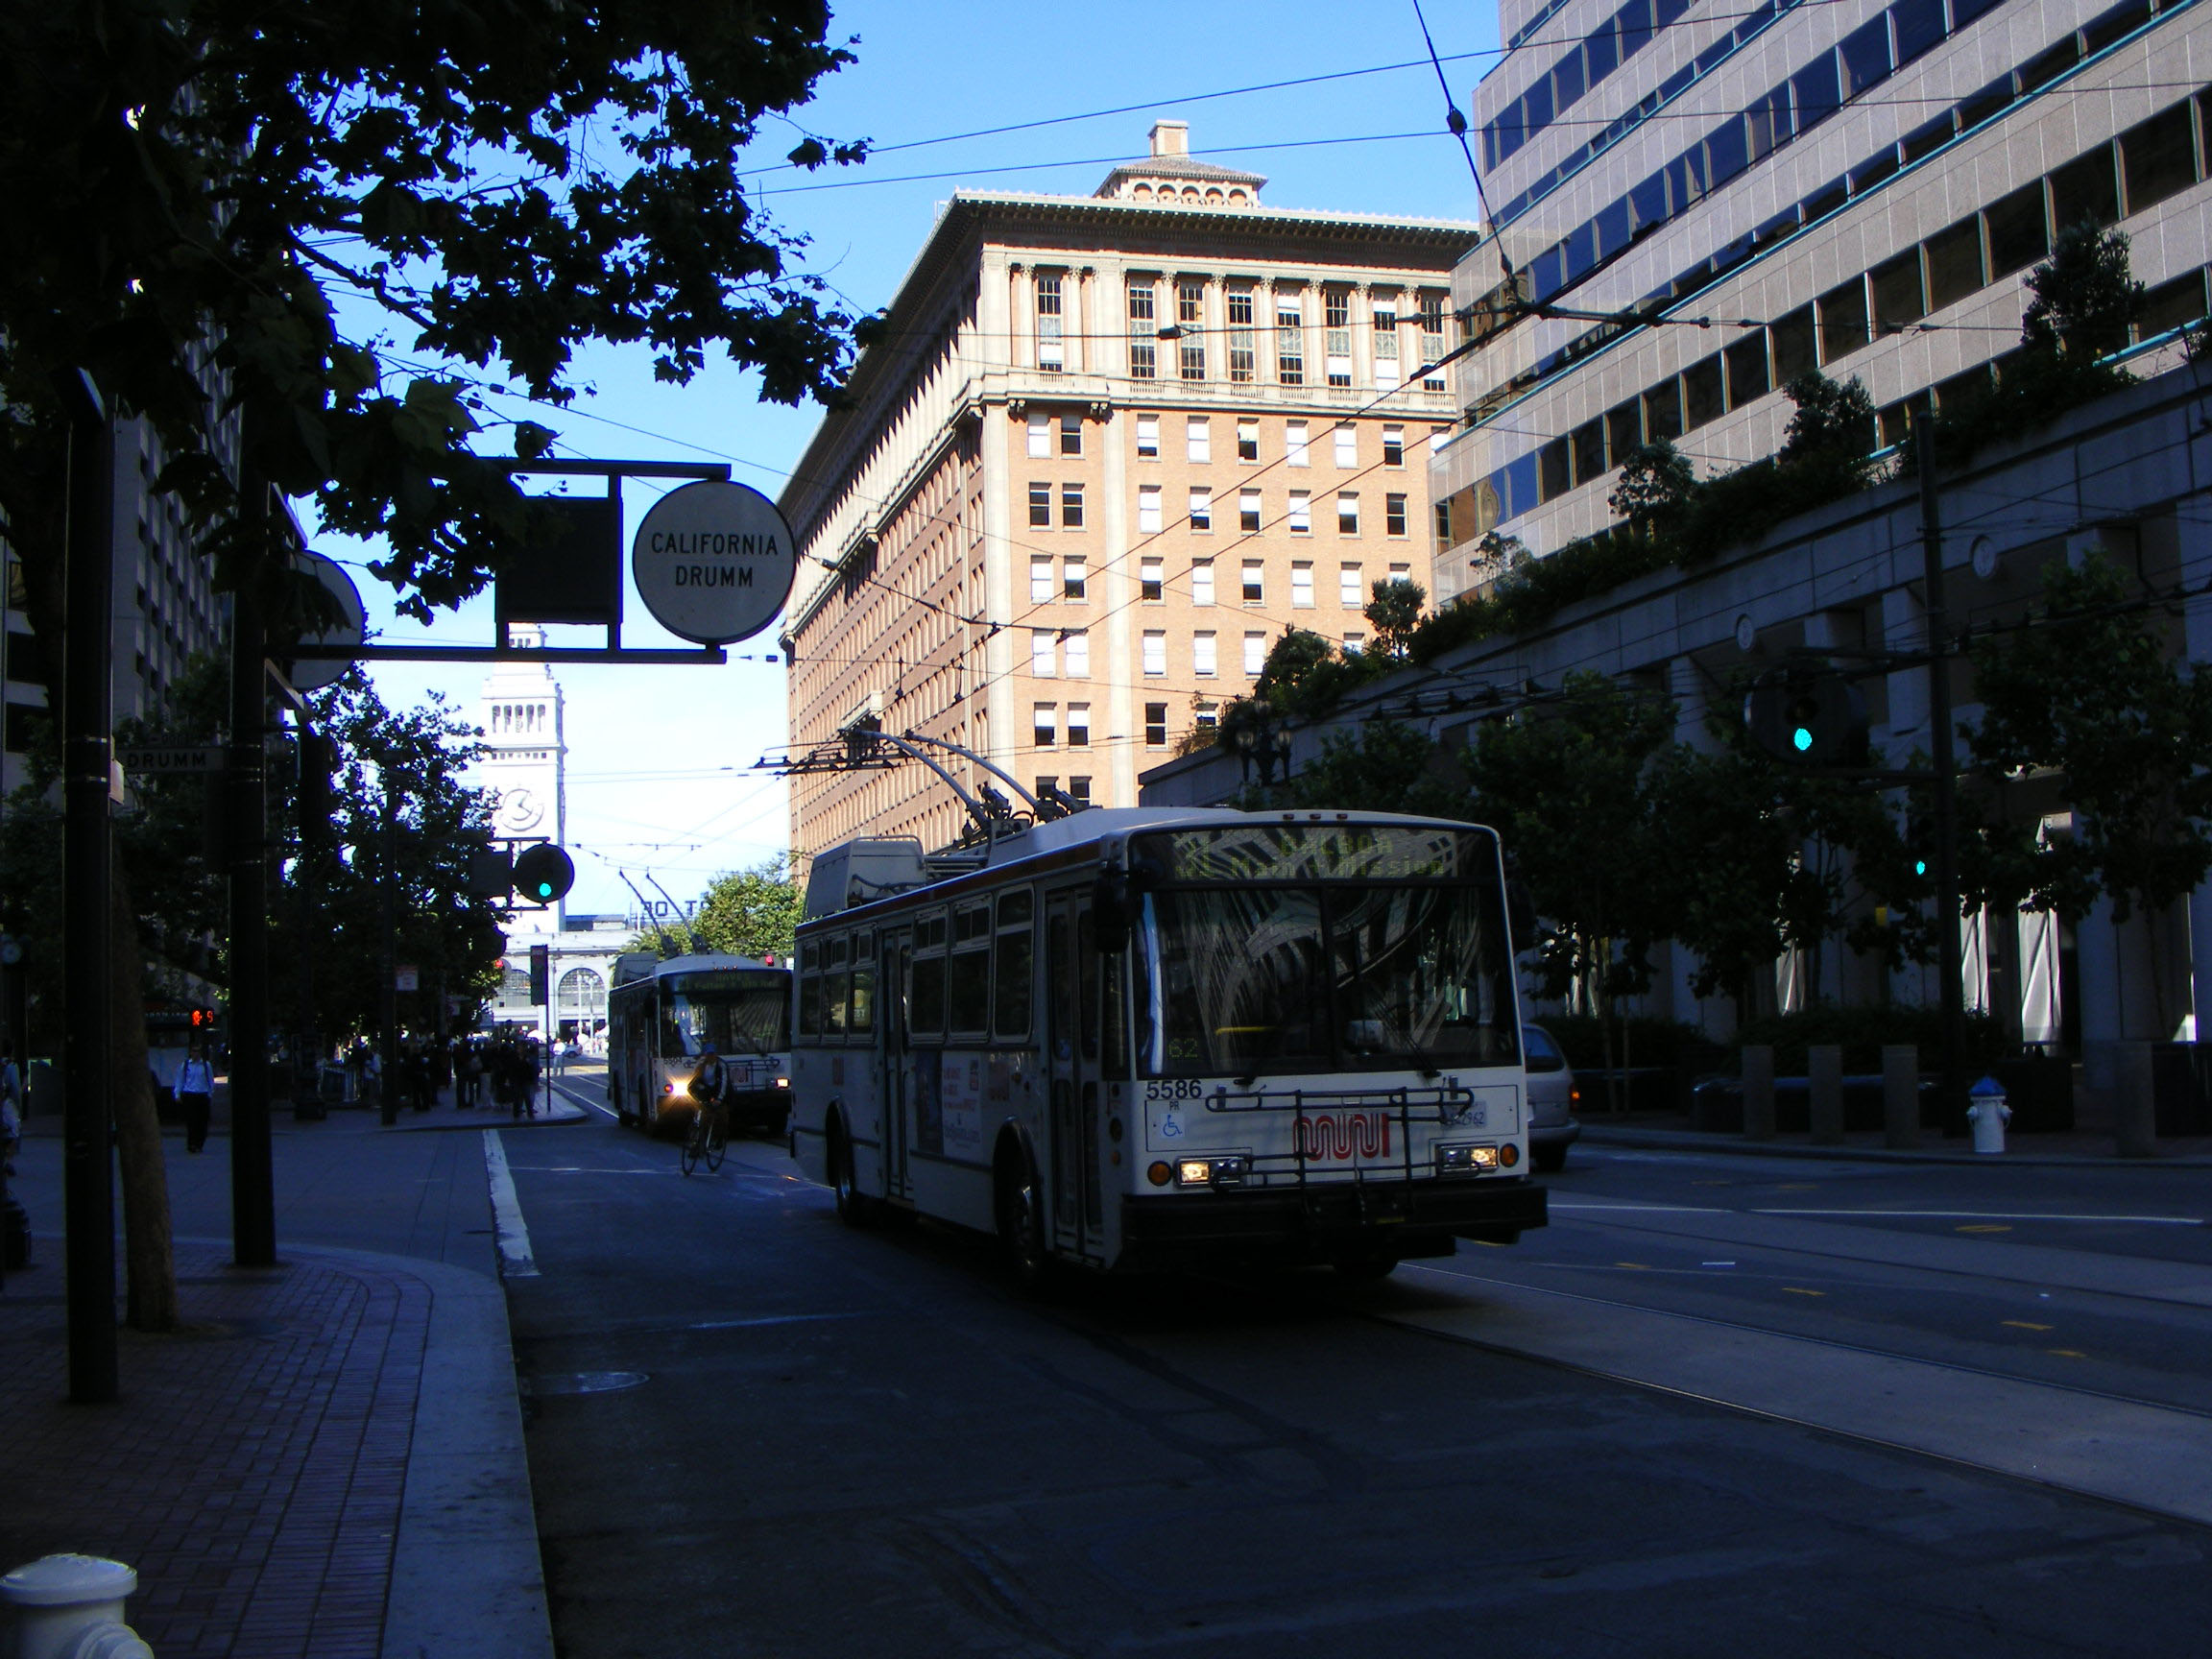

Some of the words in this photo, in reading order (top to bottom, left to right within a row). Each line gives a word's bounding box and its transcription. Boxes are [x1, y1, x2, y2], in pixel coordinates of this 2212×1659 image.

[652, 532, 779, 556] CALIFORNIA
[675, 565, 754, 588] DRUMM
[128, 752, 206, 768] DRUMM
[1145, 1079, 1202, 1099] 5586
